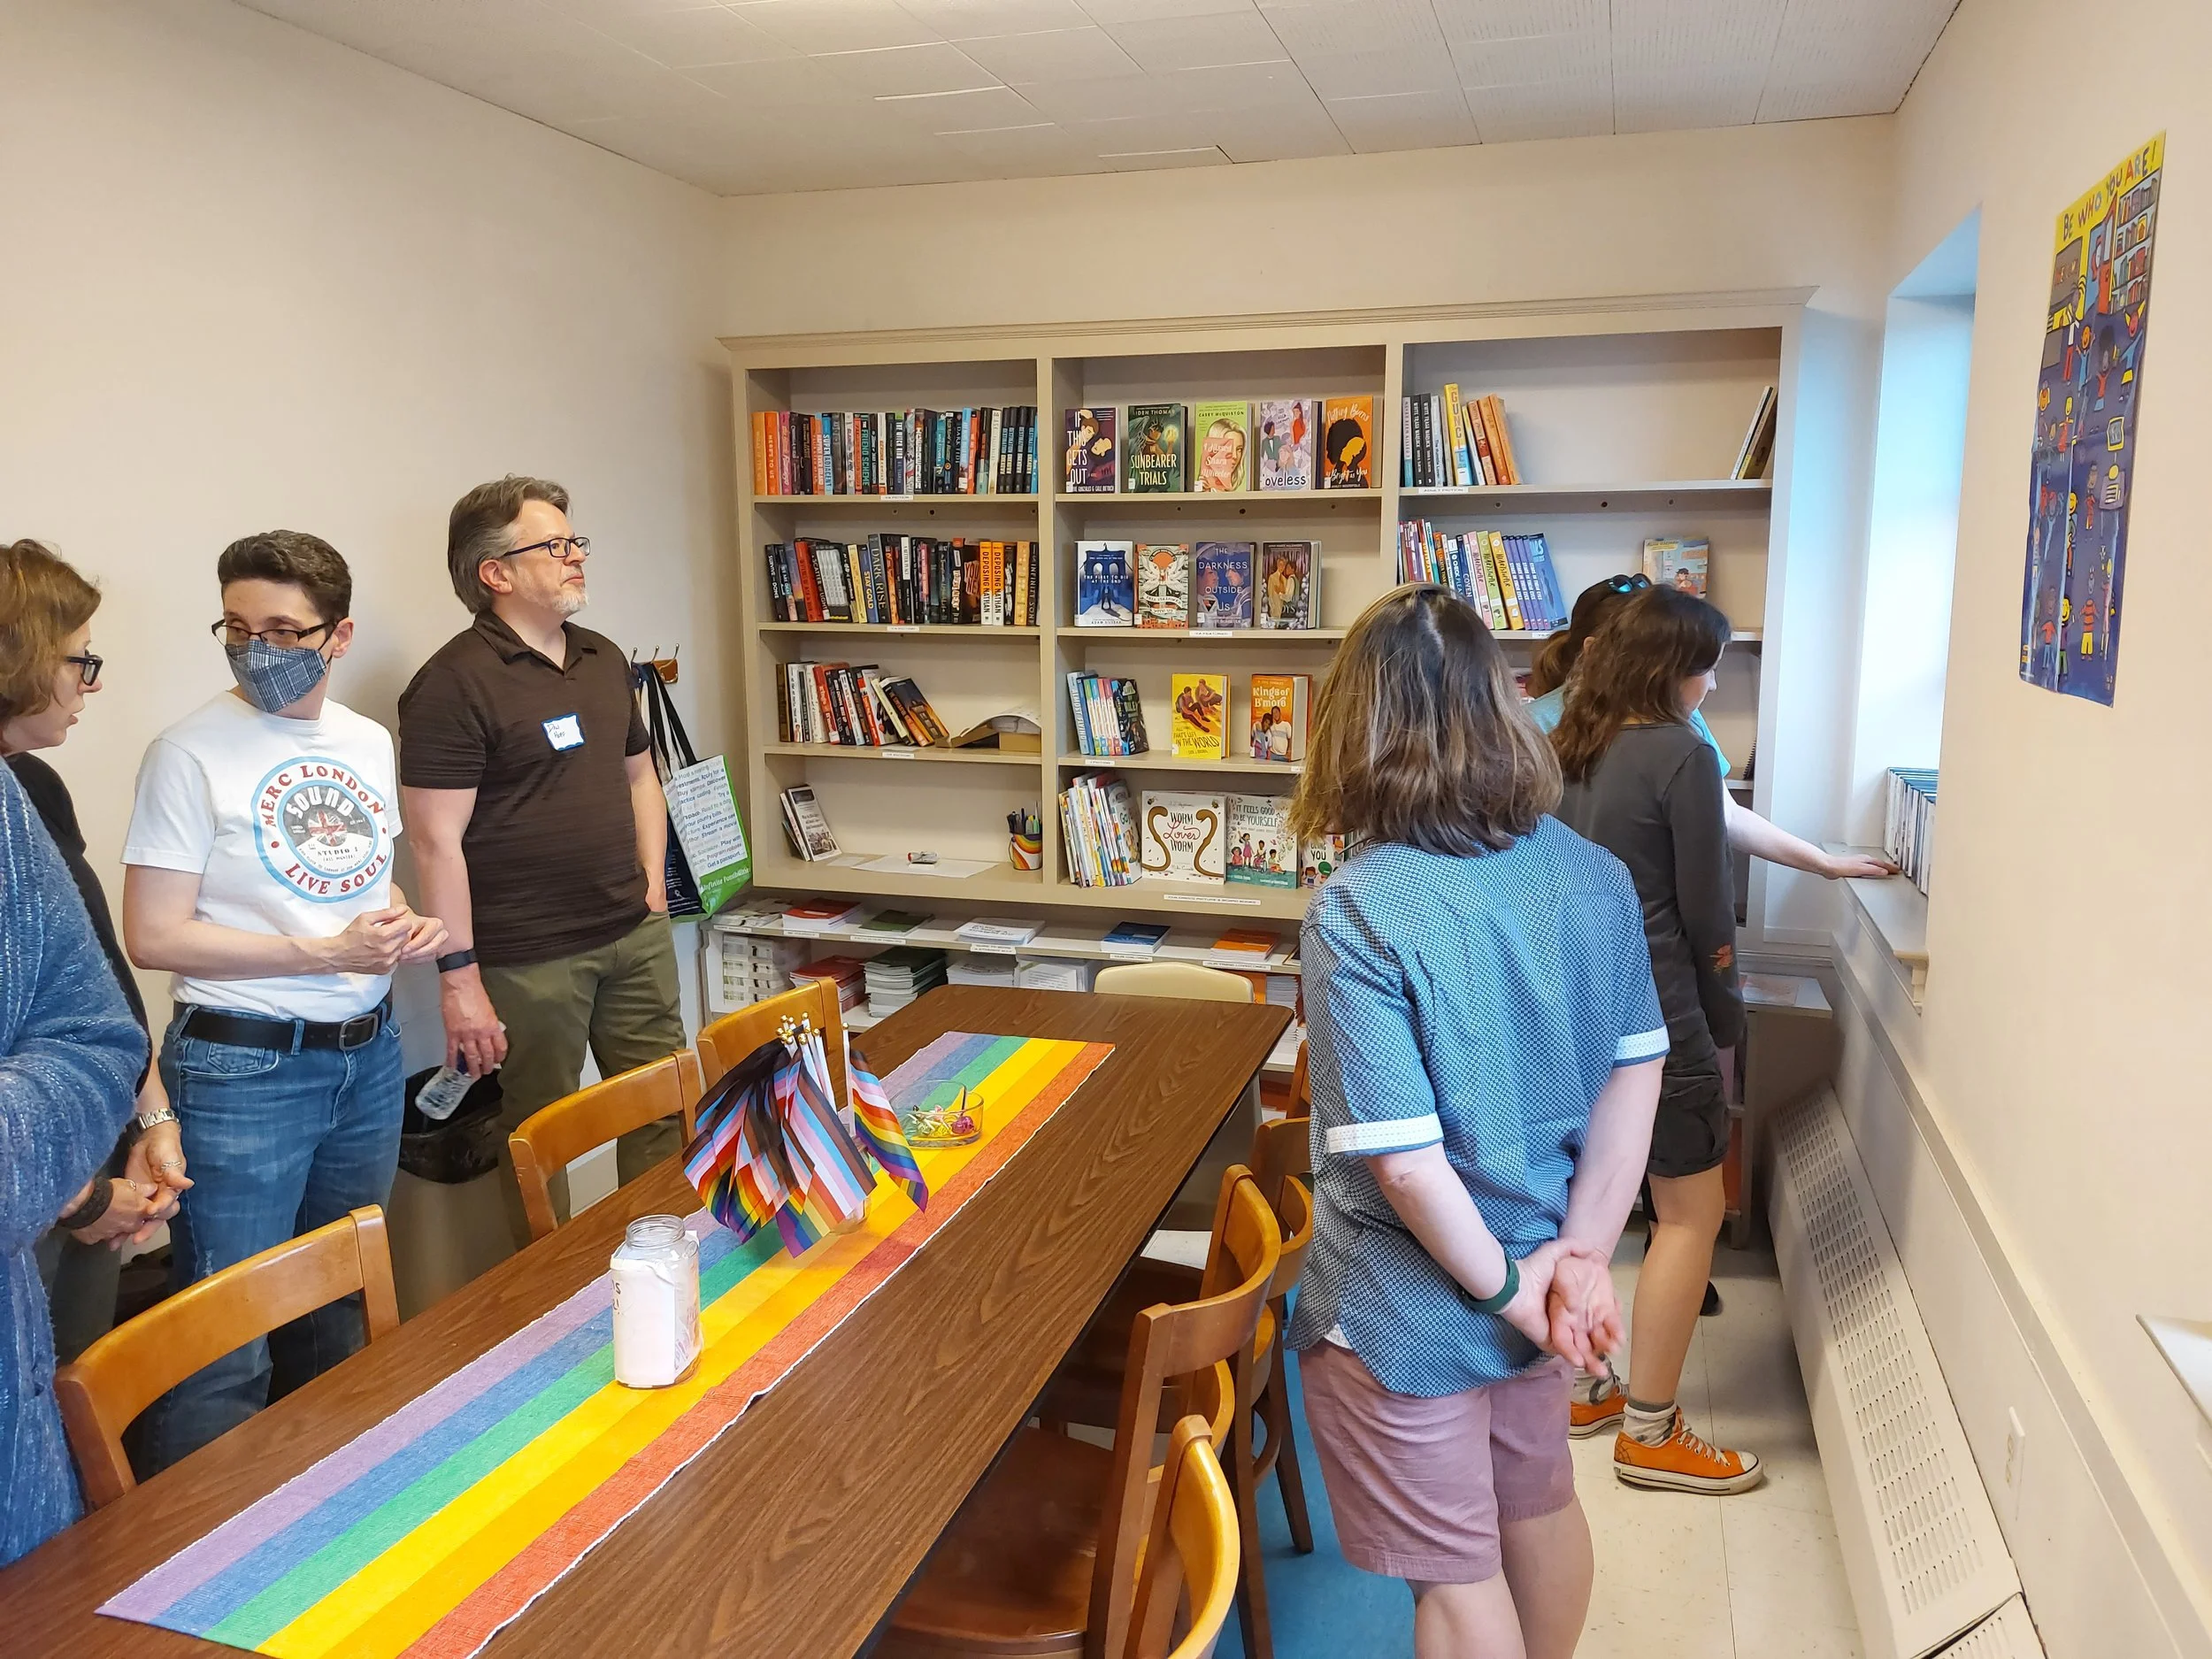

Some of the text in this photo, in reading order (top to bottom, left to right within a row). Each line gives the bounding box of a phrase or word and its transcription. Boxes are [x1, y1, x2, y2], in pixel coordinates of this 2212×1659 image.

[2063, 213, 2074, 242] BE
[2078, 190, 2102, 227] WHO
[2106, 168, 2123, 202] YOU
[1075, 411, 1081, 427] IF
[1067, 430, 1087, 447] THIS
[1067, 449, 1087, 465] GETS
[1131, 452, 1177, 471] SUNBEARER
[770, 470, 775, 479] US
[1071, 468, 1087, 484] OUT
[1140, 471, 1167, 486] TRIALS
[1264, 472, 1307, 486] oveless
[1215, 548, 1228, 557] THE
[811, 558, 821, 585] SCATTER
[1198, 559, 1248, 570] DARKNESS
[1473, 552, 1485, 582] HEARTSTOPPER
[1483, 553, 1495, 587] HEARTSTOPPER
[1496, 554, 1511, 588] HEARTSTOPPER
[871, 548, 886, 609] DARK RISE
[1463, 573, 1472, 597] COVEN
[1205, 586, 1243, 595] OUTSIDE
[1217, 602, 1231, 611] US
[1253, 687, 1279, 700] Kings
[1255, 696, 1286, 707] B'more
[1071, 689, 1086, 740] ALMOST FLYING
[1192, 736, 1220, 749] WORLD
[261, 764, 384, 827] MERC LONDON
[286, 786, 355, 819] SOUND
[1243, 804, 1259, 814] FEELS
[1260, 806, 1276, 816] GOOD
[1170, 812, 1194, 825] WORM
[1247, 814, 1278, 827] YOURSELF
[1163, 820, 1201, 843] Loves
[1170, 840, 1194, 853] WORM
[1310, 850, 1326, 861] YOU
[285, 863, 331, 895] LIVE
[341, 854, 388, 893] SOUL
